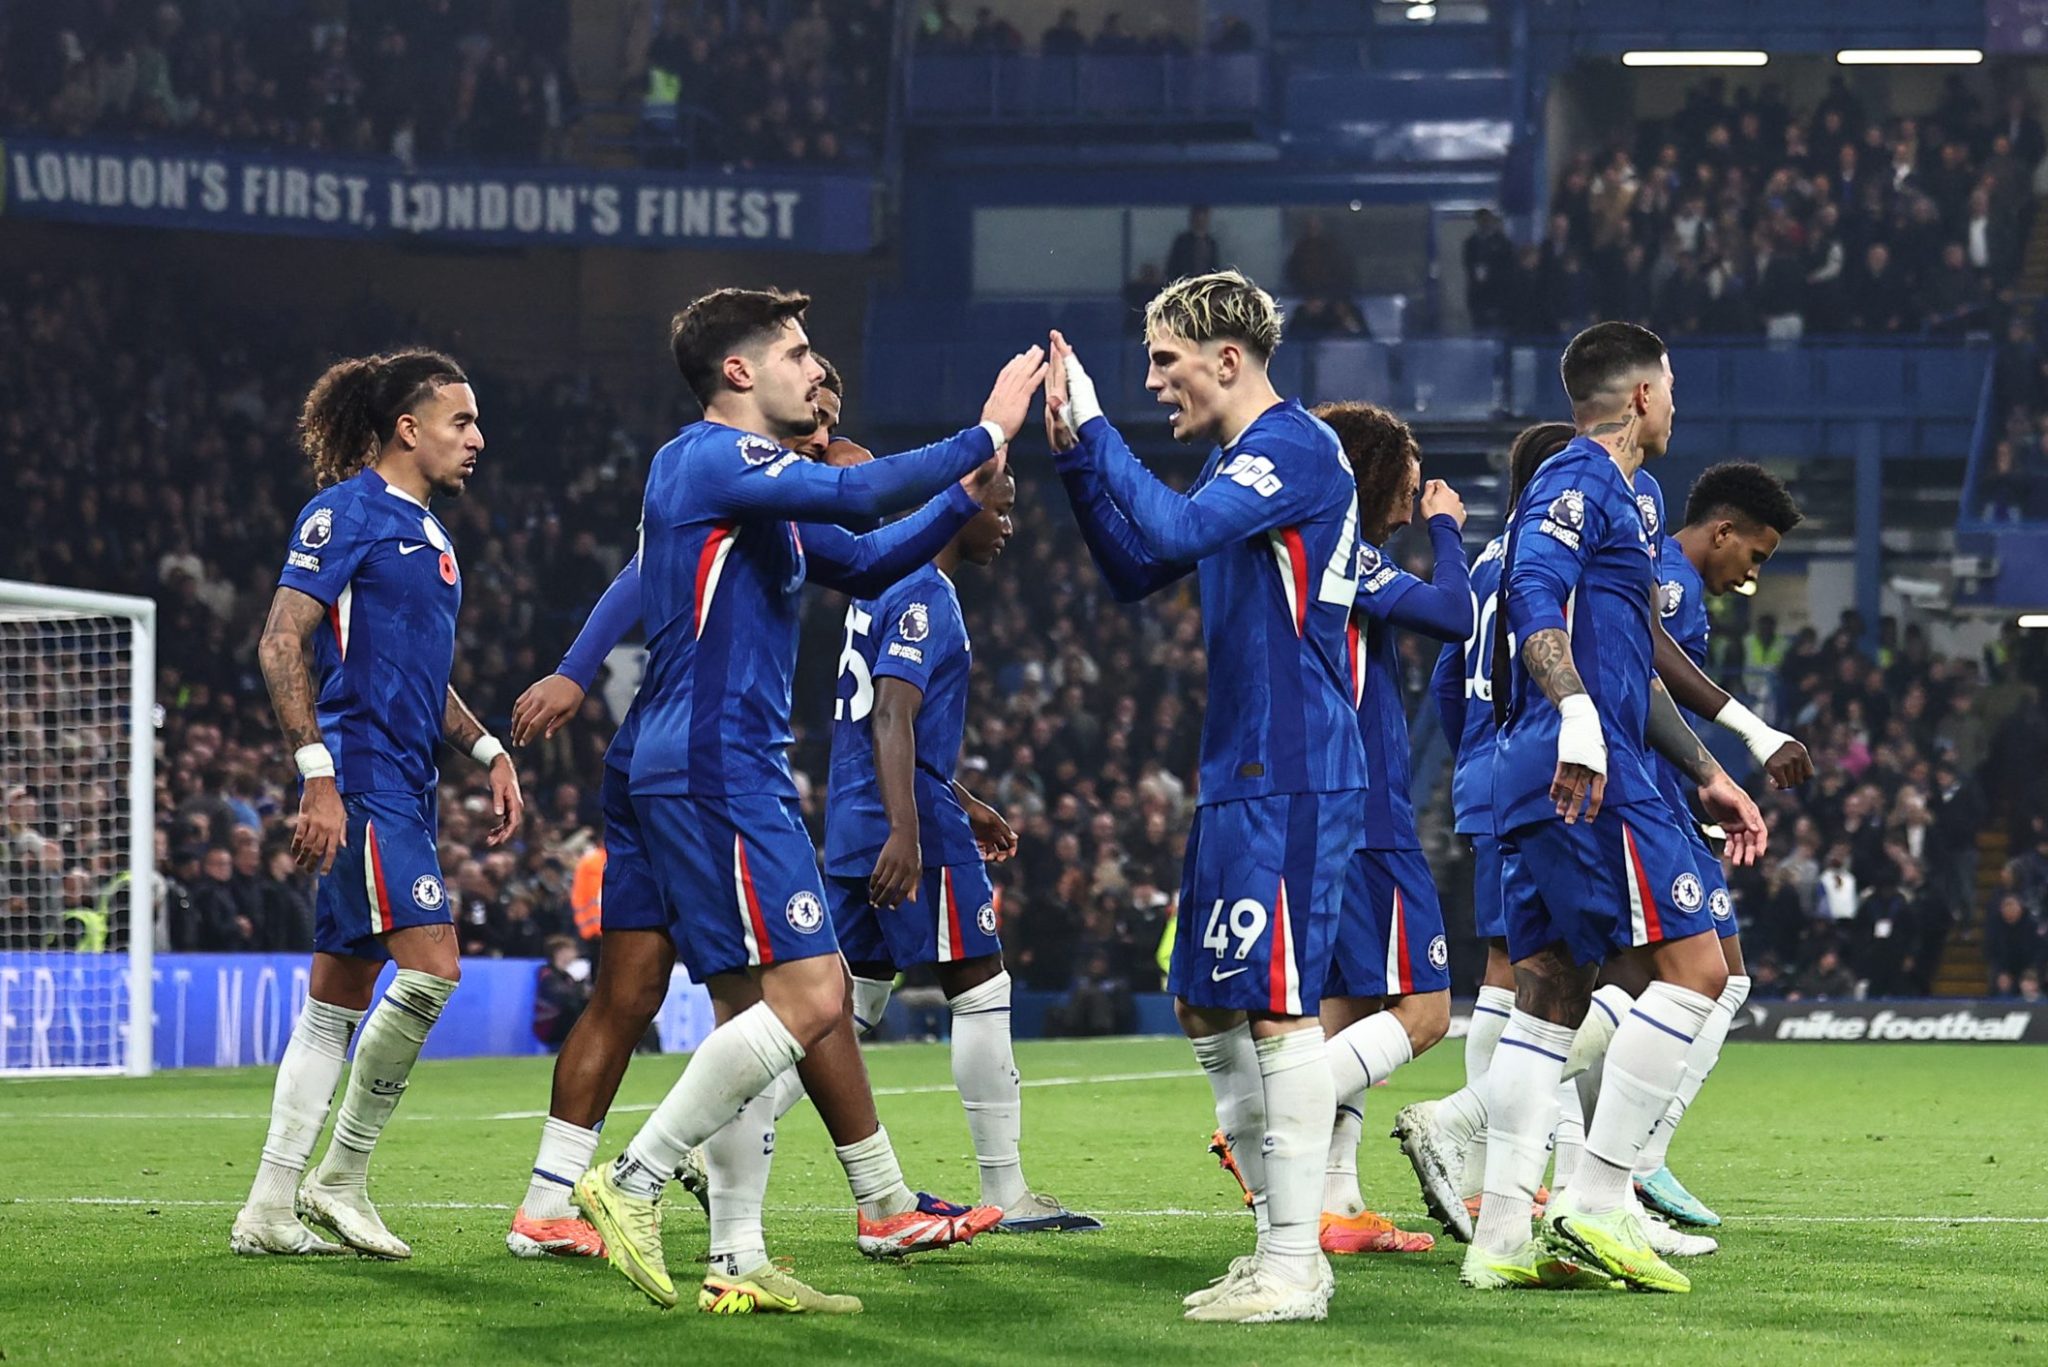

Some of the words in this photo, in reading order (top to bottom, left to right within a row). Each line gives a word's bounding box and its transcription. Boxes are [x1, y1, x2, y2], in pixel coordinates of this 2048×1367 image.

[13, 150, 229, 213] LONDON'S
[242, 165, 376, 231] FIRST,
[388, 181, 621, 236] LONDON'S
[636, 187, 800, 240] FINEST
[1202, 898, 1267, 960] 49
[1776, 1010, 1867, 1040] nike
[1867, 1009, 2032, 1041] football
